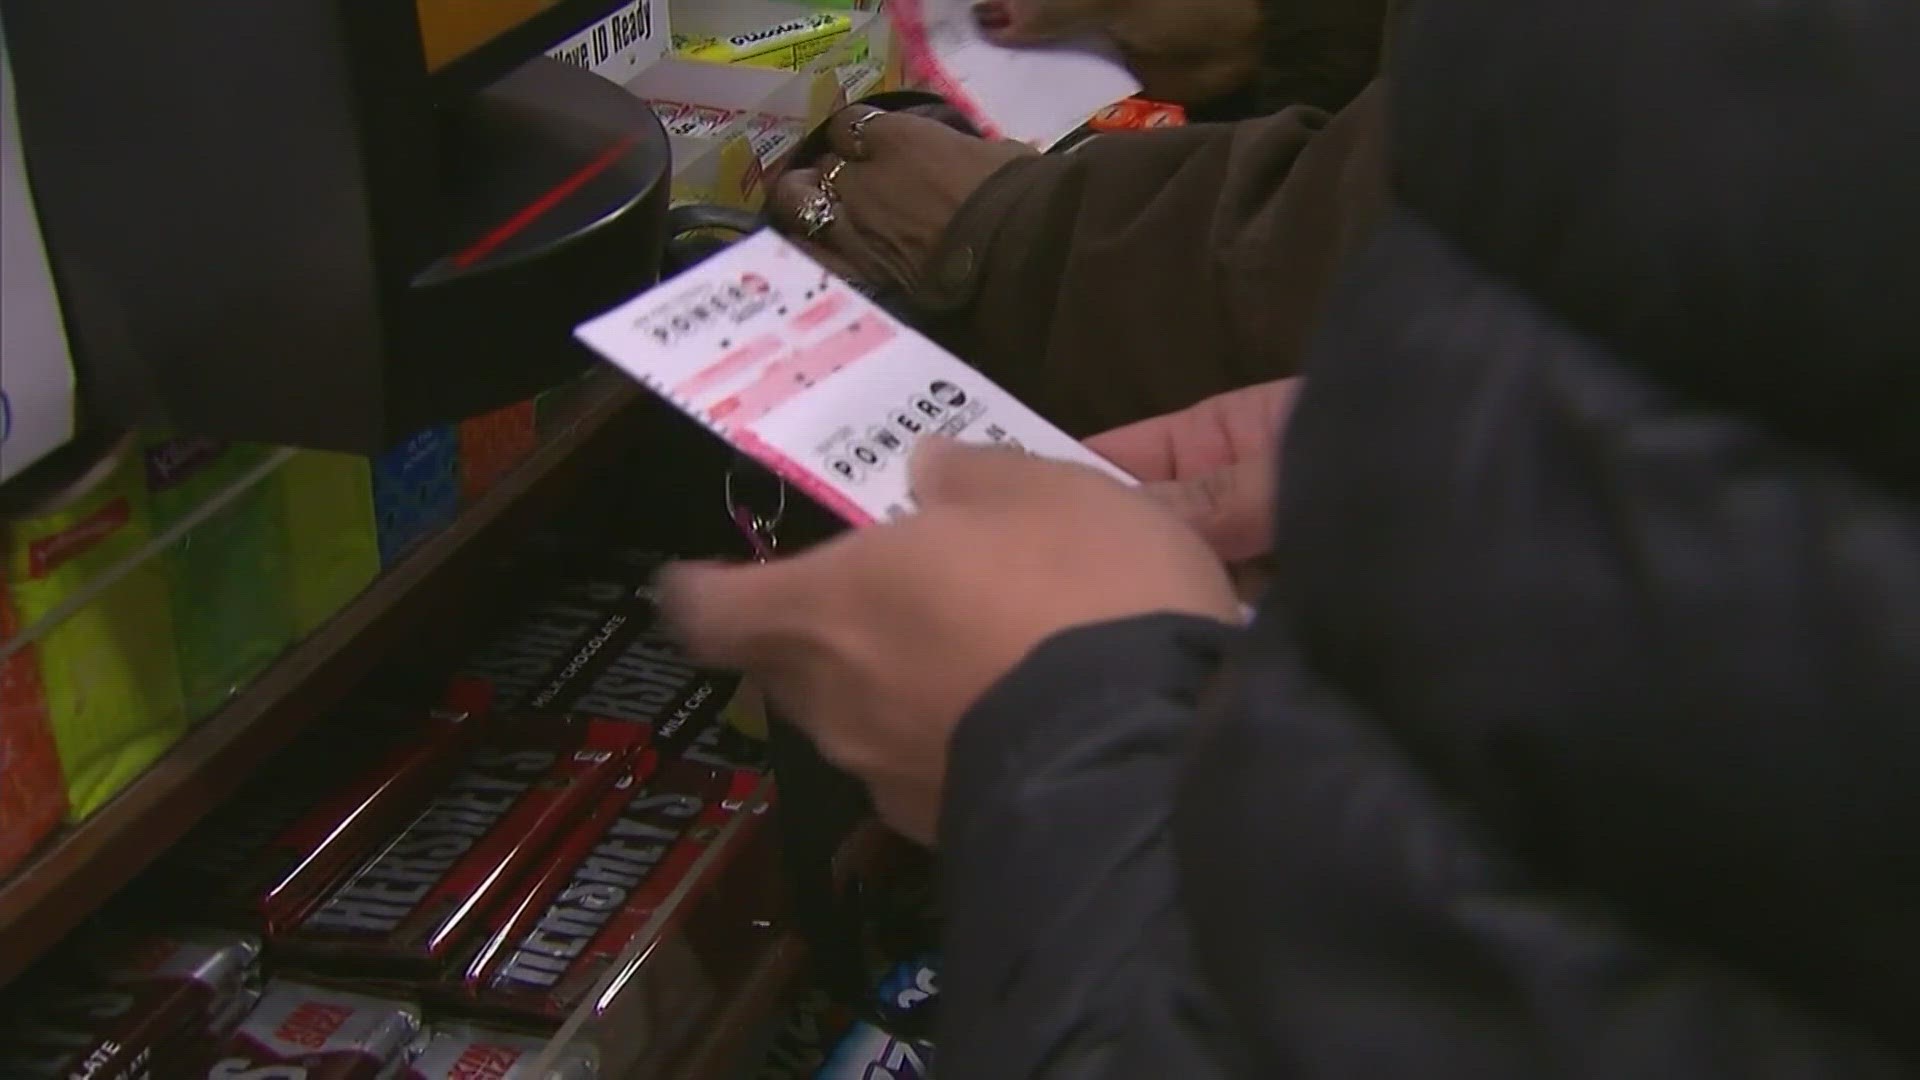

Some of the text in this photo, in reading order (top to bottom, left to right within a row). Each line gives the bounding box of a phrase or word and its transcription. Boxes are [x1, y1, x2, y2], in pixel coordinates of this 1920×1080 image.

[592, 24, 608, 66] ID
[611, 0, 651, 54] Ready
[834, 398, 943, 478] POWER
[559, 609, 627, 683] CHOCOLATE
[658, 706, 689, 741] MILK
[303, 750, 558, 933] HERSHEY'S
[492, 789, 703, 988] HERSHEY'S
